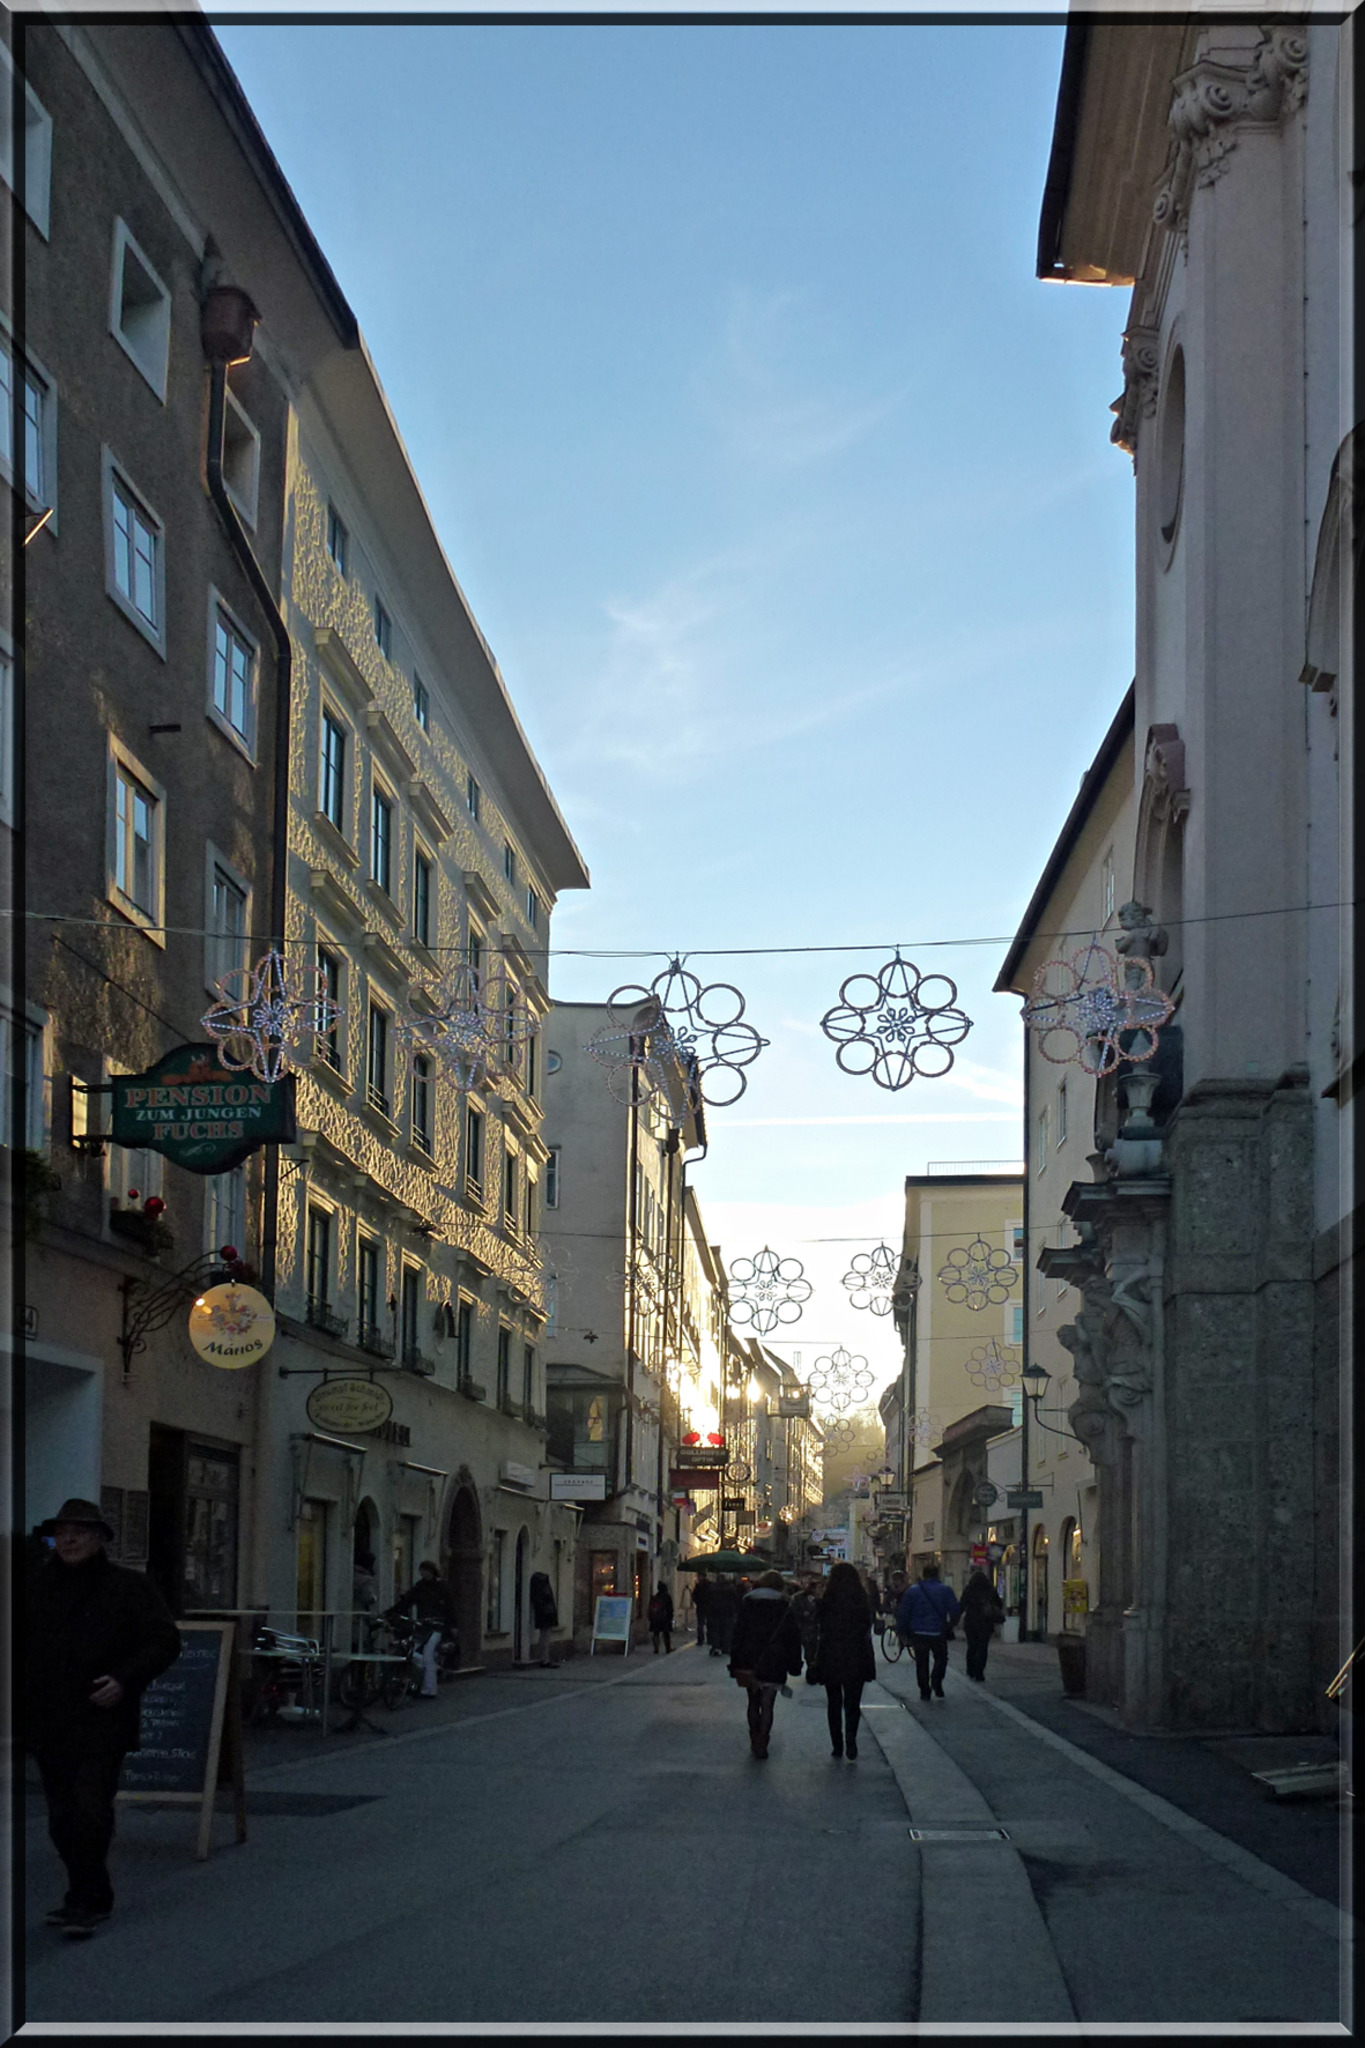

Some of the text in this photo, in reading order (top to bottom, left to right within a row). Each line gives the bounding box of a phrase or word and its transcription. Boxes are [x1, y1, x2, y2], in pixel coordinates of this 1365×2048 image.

[124, 1084, 272, 1108] PENSION
[136, 1107, 262, 1121] ZUM JUNGEN
[152, 1121, 245, 1140] FUCHS
